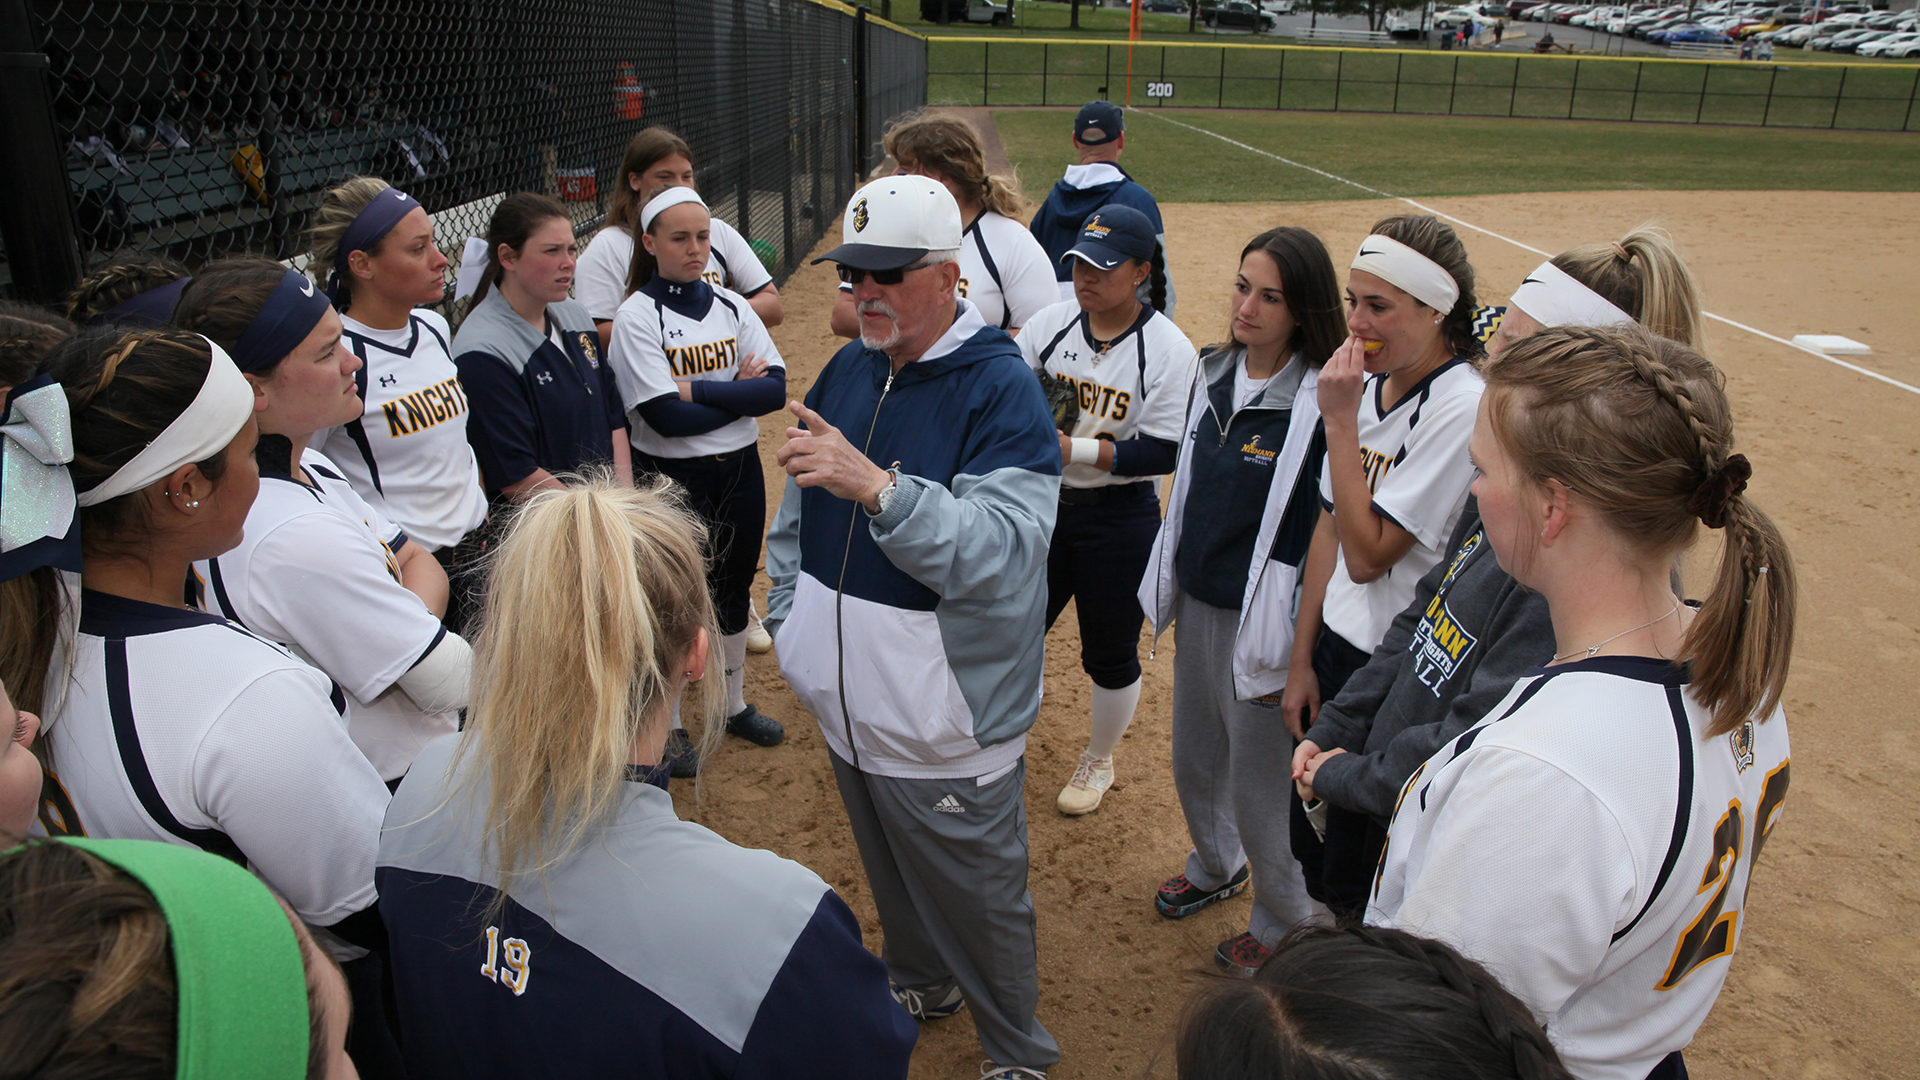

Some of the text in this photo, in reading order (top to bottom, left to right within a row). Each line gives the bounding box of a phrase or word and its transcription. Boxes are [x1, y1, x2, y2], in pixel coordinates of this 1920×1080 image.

[1147, 82, 1173, 97] 200
[664, 337, 739, 377] KNIGHT
[380, 375, 468, 438] KNIGHT
[1056, 372, 1131, 422] GHTS
[933, 805, 965, 813] adidas
[480, 925, 531, 997] 19
